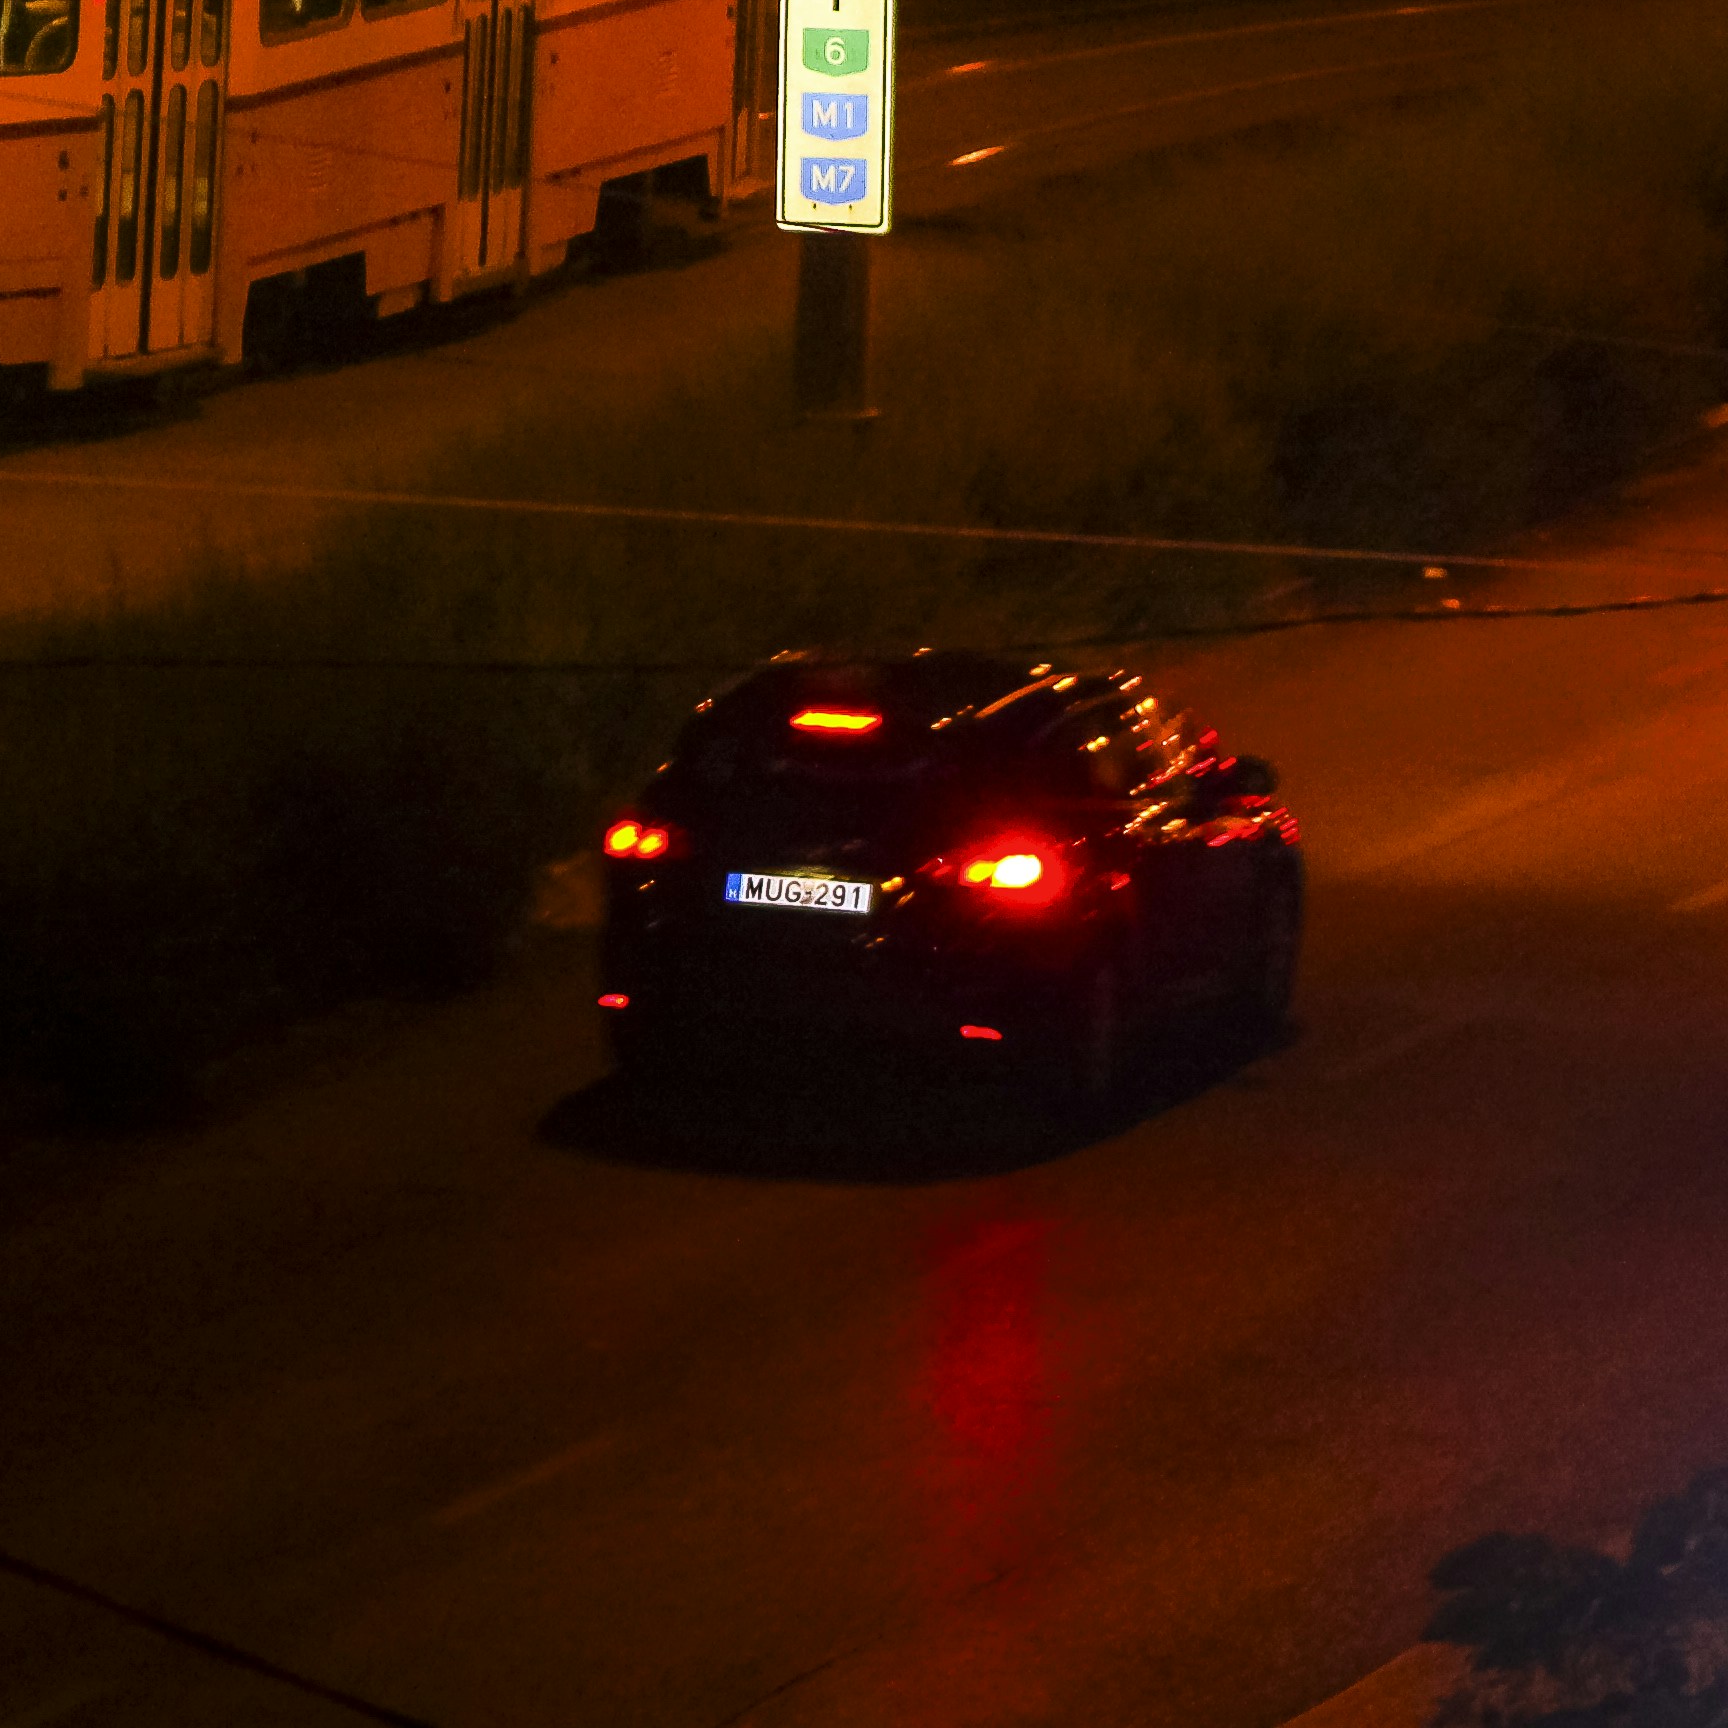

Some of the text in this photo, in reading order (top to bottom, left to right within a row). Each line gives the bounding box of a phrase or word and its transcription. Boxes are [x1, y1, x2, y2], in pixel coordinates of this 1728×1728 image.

[824, 36, 847, 66] 6
[812, 99, 855, 130] M1
[811, 164, 856, 193] M7
